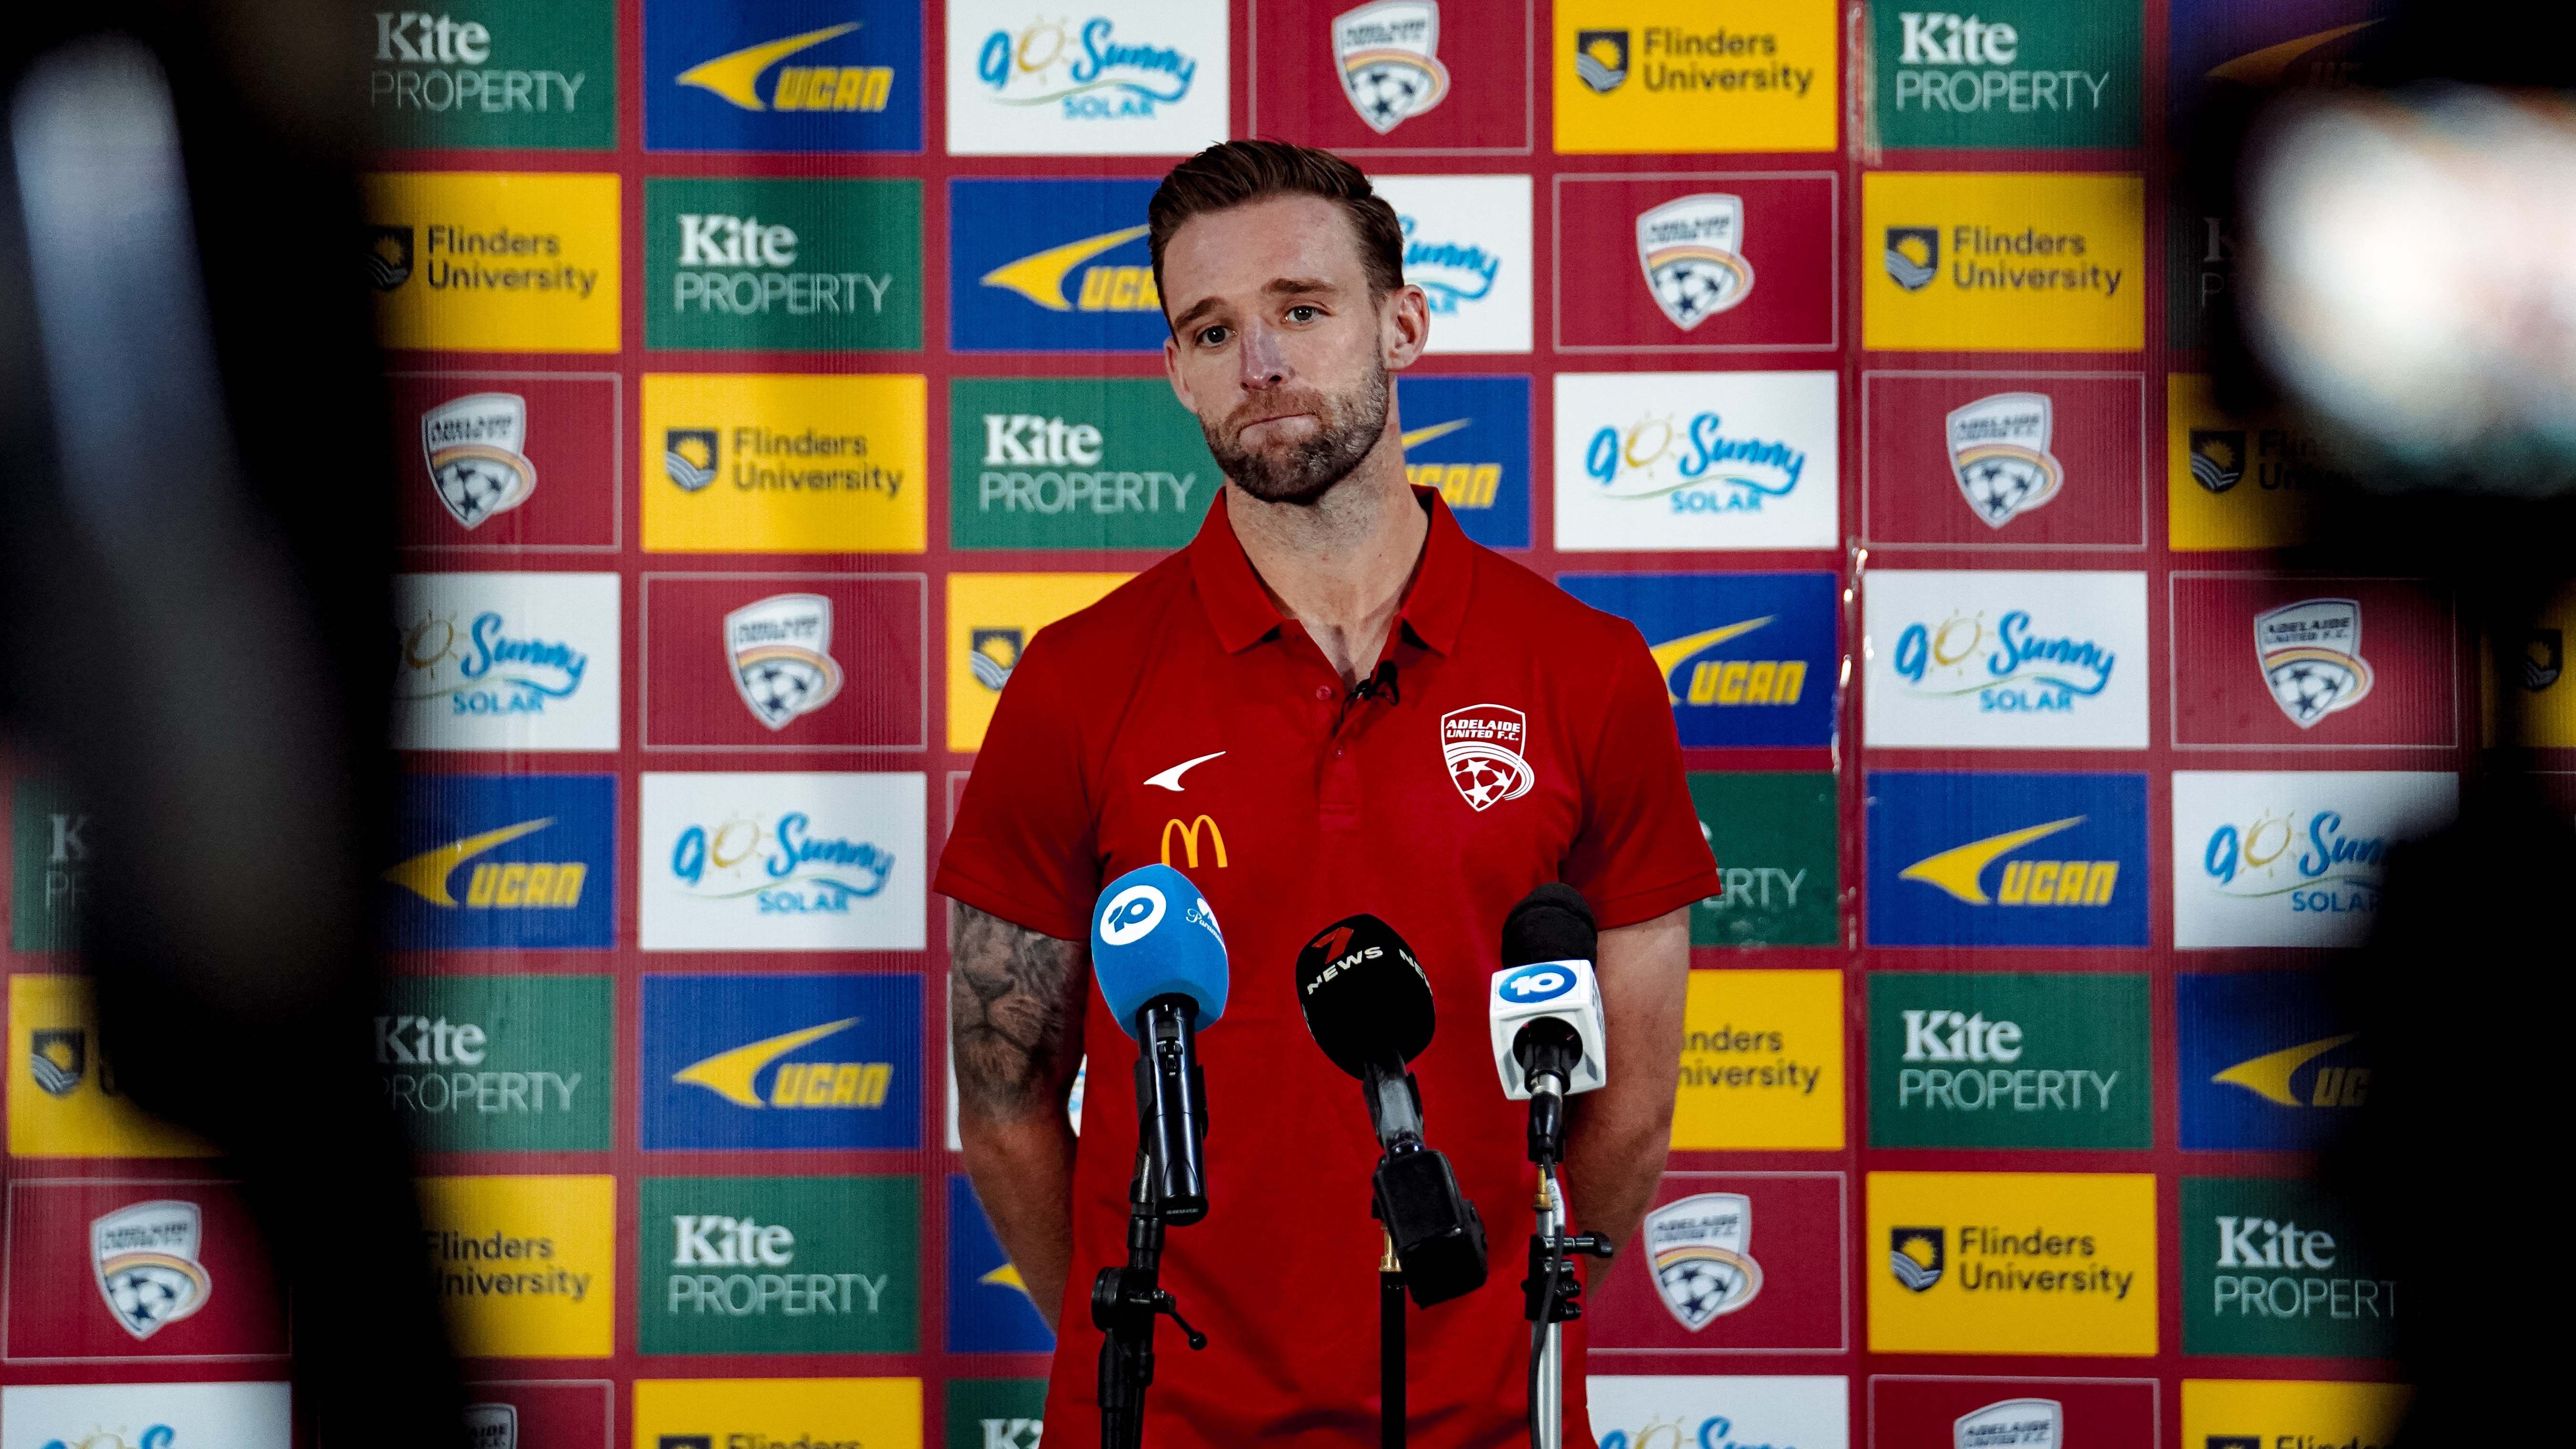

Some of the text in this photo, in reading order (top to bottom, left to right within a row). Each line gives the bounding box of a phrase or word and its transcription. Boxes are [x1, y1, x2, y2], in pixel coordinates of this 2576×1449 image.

[376, 12, 491, 65] Kite
[1643, 27, 1777, 56] Flinders
[1899, 12, 2018, 65] Kite
[1071, 17, 1197, 103] Sunny
[1643, 63, 1814, 98] University
[371, 71, 586, 113] PROPERTY
[1063, 94, 1156, 119] SOLAR
[1896, 70, 2110, 113] PROPERTY
[428, 225, 561, 256] Flinders
[676, 213, 798, 267] Kite
[1953, 226, 2087, 257] Flinders
[428, 260, 599, 299] University
[673, 271, 893, 316] PROPERTY
[1078, 265, 1164, 312] UCA
[1952, 260, 2122, 297] University
[732, 427, 868, 457] Flinders
[984, 414, 1103, 466] Kite
[1679, 412, 1807, 497] Sunny
[731, 461, 903, 501] University
[979, 472, 1196, 514] PROPERTY
[1670, 490, 1763, 514] SOLAR
[460, 612, 588, 698] Sunny
[1989, 609, 2116, 698] Sunny
[453, 690, 546, 716] SOLAR
[1689, 661, 1808, 705] UCAN
[1979, 688, 2073, 714] SOLAR
[1445, 719, 1521, 732] ADELAIDE
[1446, 730, 1519, 740] UNITED F.C.
[766, 812, 896, 898] Sunny
[466, 862, 588, 909] UCAN
[757, 889, 851, 915] SOLAR
[1997, 861, 2121, 906] UCAN
[1108, 897, 1154, 933] 10
[1307, 946, 1383, 995] NEWS
[1510, 972, 1565, 996] 10
[375, 1015, 487, 1066] Kite
[1684, 1023, 1784, 1052] nders
[1902, 1010, 2024, 1063] Kite
[770, 1062, 894, 1109] UCAN
[1680, 1058, 1822, 1096] niversity
[1899, 1069, 2120, 1111] PROPERTY
[2311, 1067, 2373, 1107] UC
[673, 1214, 795, 1267] Kite
[1959, 1225, 2096, 1258] Flinders
[2215, 1215, 2336, 1270] Kite
[668, 1274, 888, 1316] PROPERTY
[1959, 1264, 2133, 1301] University
[2213, 1275, 2398, 1320] PROPERT
